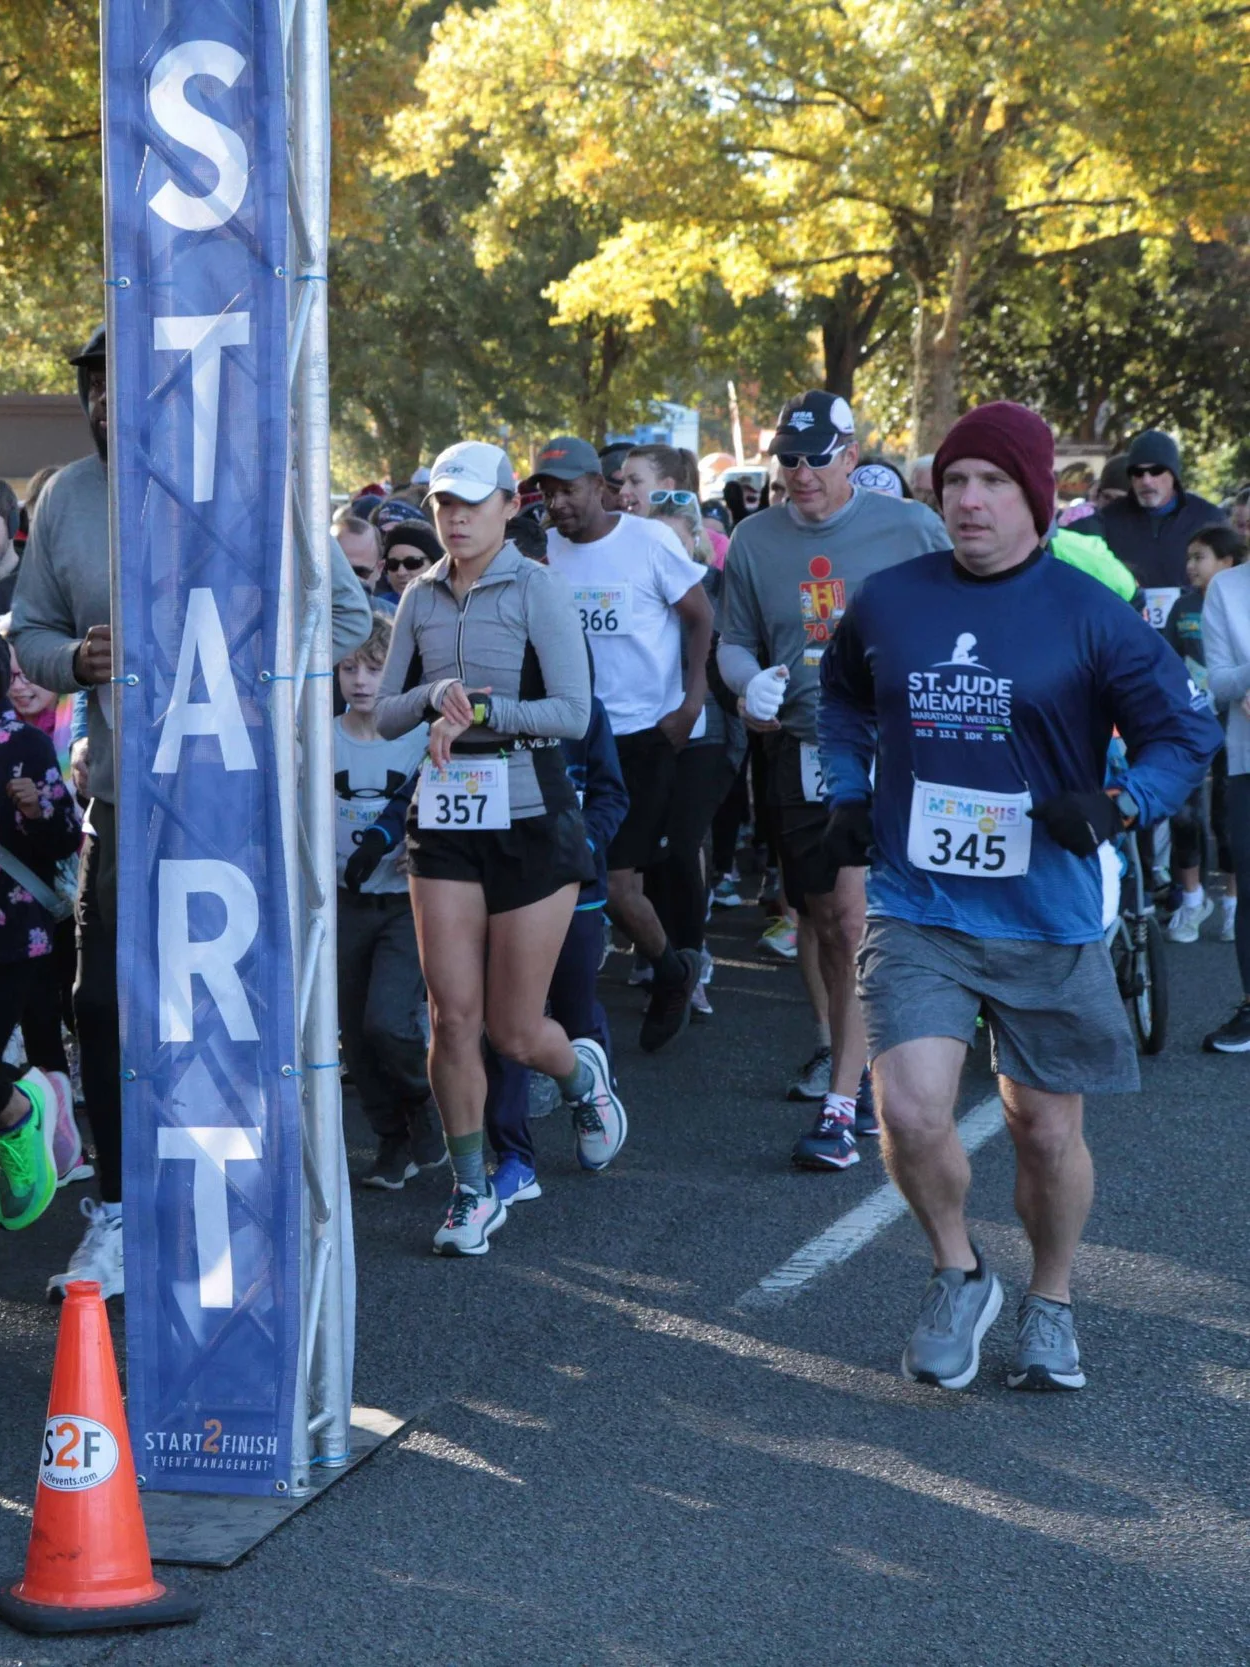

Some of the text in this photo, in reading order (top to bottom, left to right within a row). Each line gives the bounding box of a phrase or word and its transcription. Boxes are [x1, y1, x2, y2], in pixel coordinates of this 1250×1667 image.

[579, 608, 618, 631] 366
[148, 39, 263, 1308] START
[908, 672, 1013, 698] ST. JUDE
[909, 692, 1011, 716] MEMPHIS
[911, 711, 963, 722] MARATHON
[915, 728, 1006, 742] 26.2 13.1 10K 5K
[430, 770, 493, 784] MEMPHIS
[435, 794, 488, 824] 357
[928, 797, 1017, 822] MEMPHIS
[928, 828, 1006, 871] 345
[43, 1422, 101, 1472] S2F
[154, 1455, 269, 1472] EVENT MANAGEMENT
[43, 1471, 99, 1486] s2fevents.com
